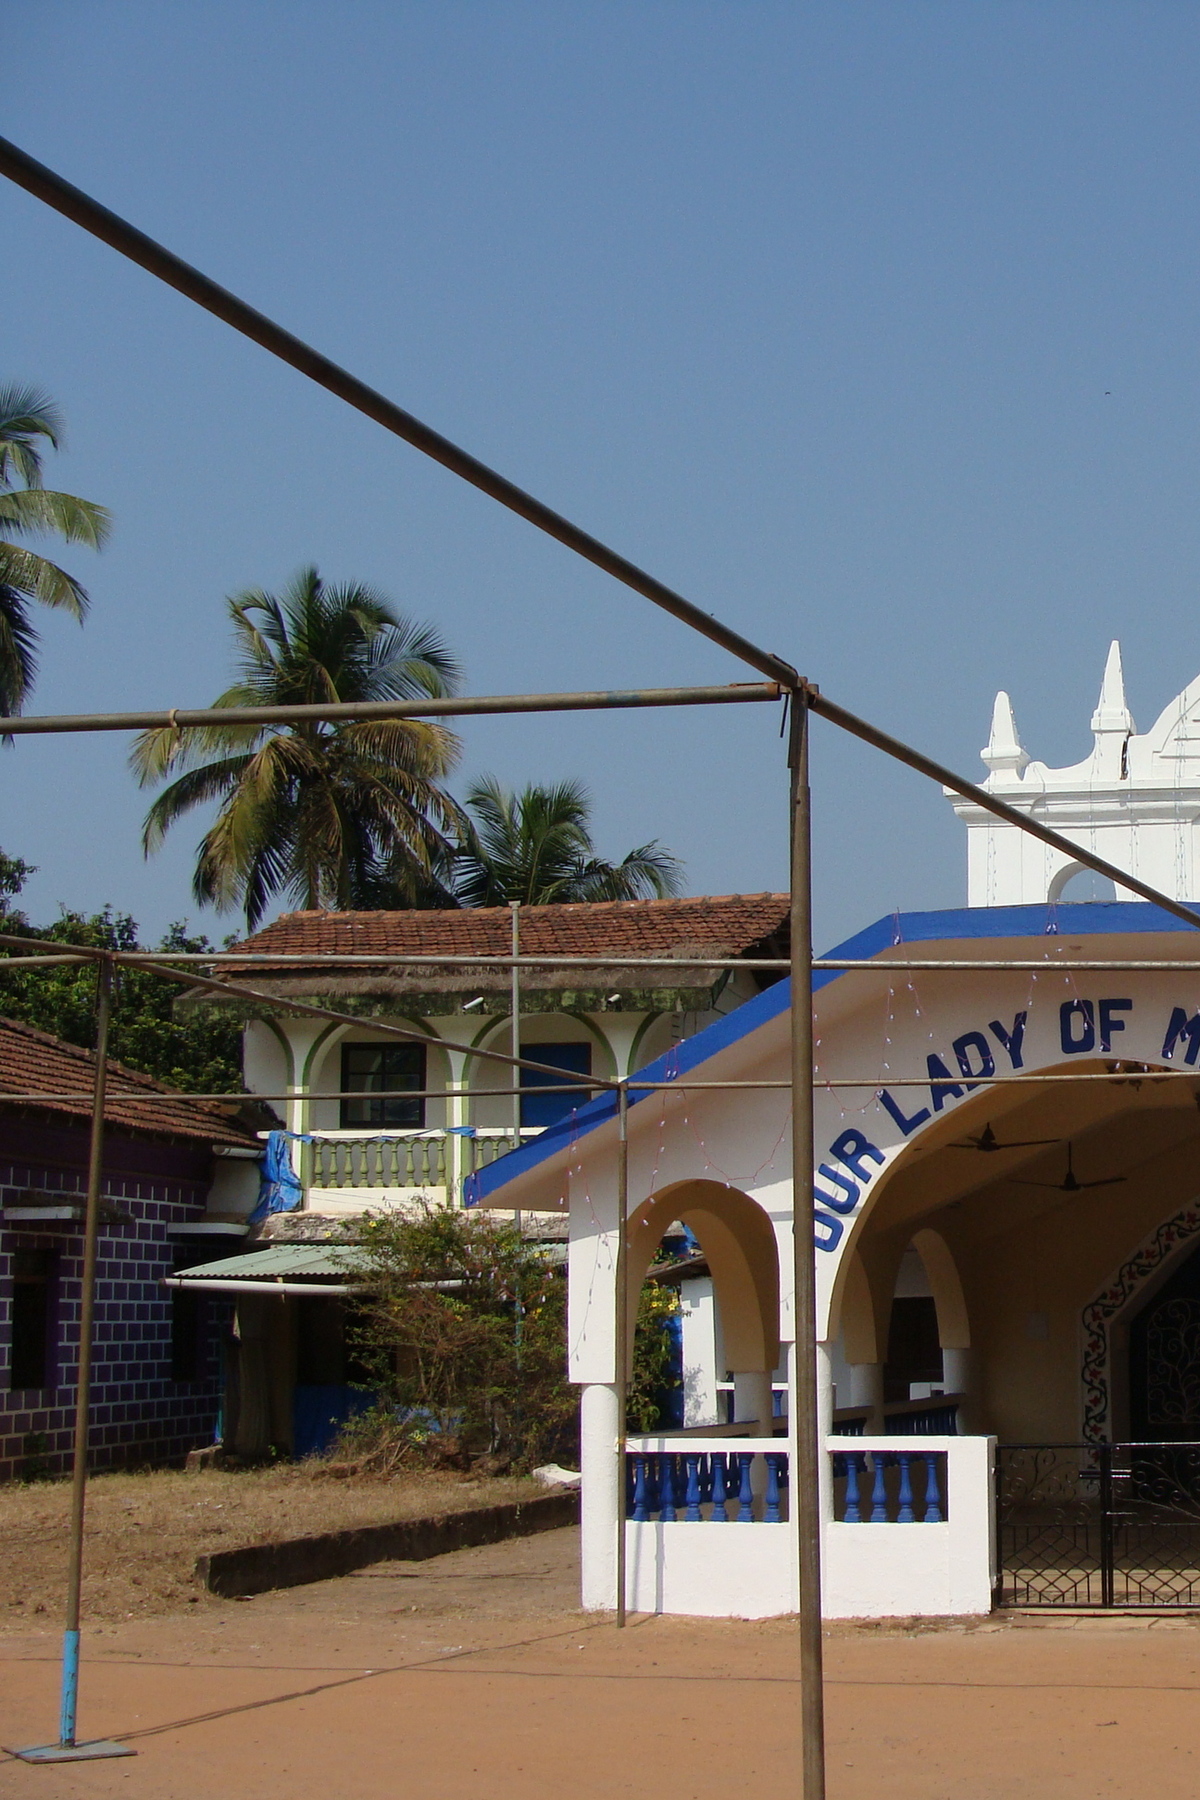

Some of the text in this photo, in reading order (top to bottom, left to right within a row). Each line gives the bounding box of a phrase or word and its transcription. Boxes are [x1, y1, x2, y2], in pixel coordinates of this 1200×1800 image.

[813, 1128, 886, 1252] OUR
[879, 1011, 1028, 1136] LADY
[1059, 998, 1133, 1054] OF
